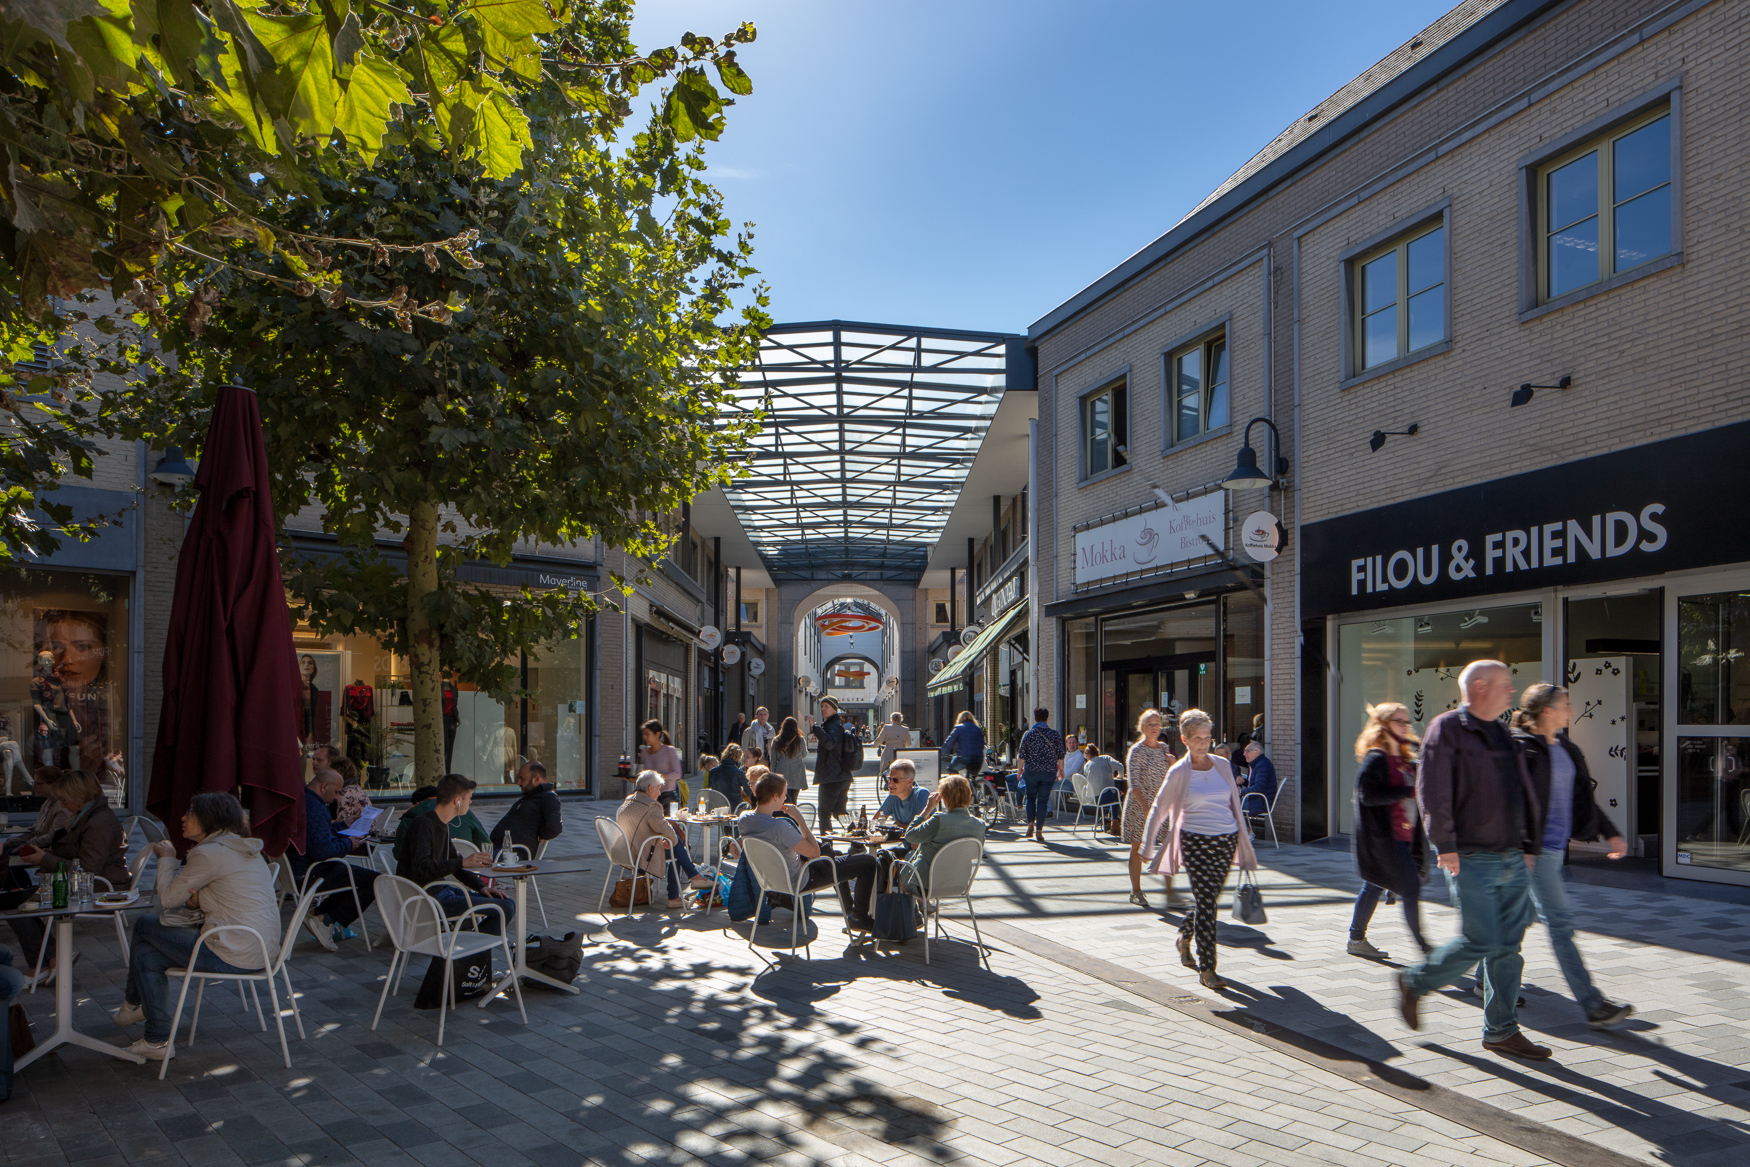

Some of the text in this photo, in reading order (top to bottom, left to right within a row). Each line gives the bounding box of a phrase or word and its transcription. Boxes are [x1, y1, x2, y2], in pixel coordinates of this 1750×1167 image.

[1080, 539, 1126, 569] Mokka
[1351, 503, 1668, 596] FILOU & FRIENDS
[539, 574, 588, 588] Mayerline
